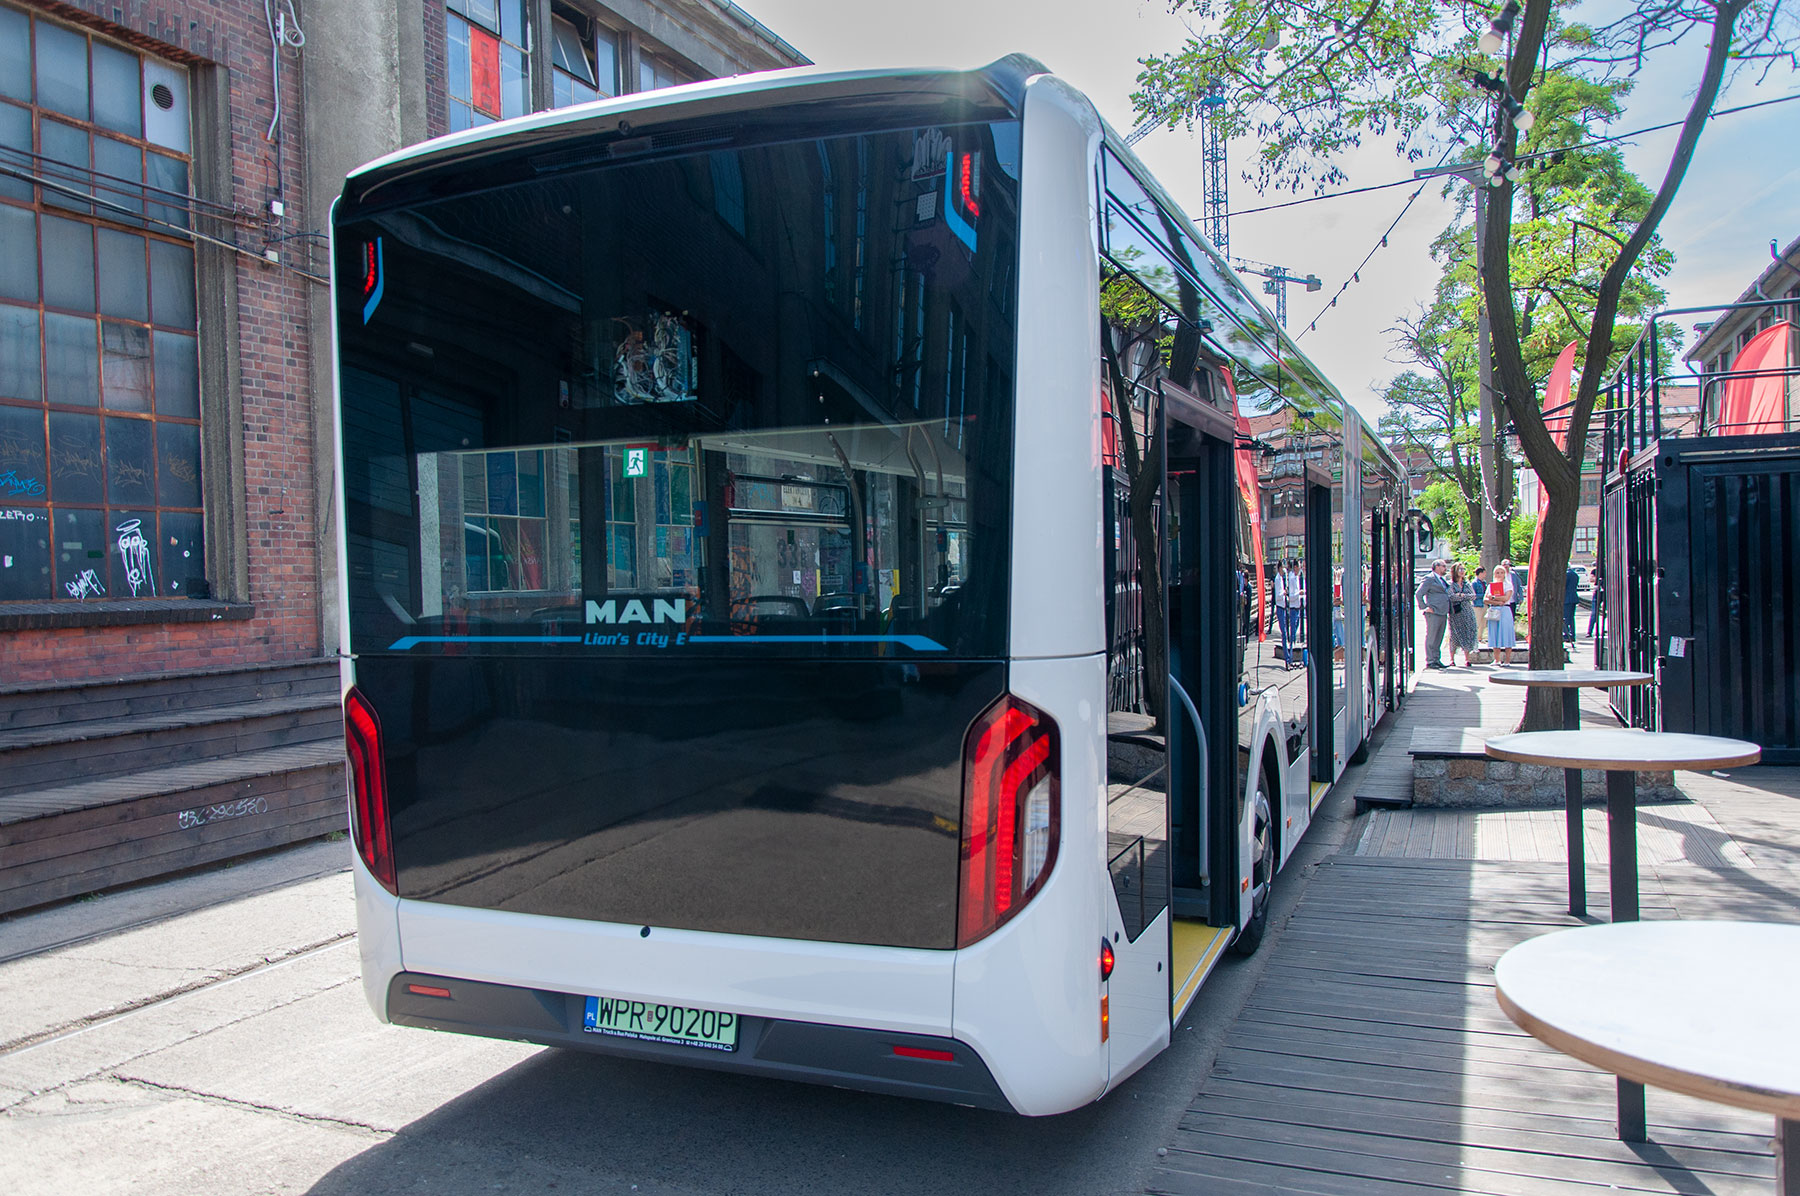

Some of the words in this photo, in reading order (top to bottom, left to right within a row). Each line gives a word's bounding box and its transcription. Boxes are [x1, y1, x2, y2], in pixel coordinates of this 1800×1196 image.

[586, 599, 686, 624] MAN
[584, 632, 629, 646] Lion's
[636, 632, 669, 648] City
[675, 632, 687, 646] E
[586, 1012, 596, 1021] PL
[599, 997, 646, 1031] WPR
[654, 1004, 733, 1040] 9020P
